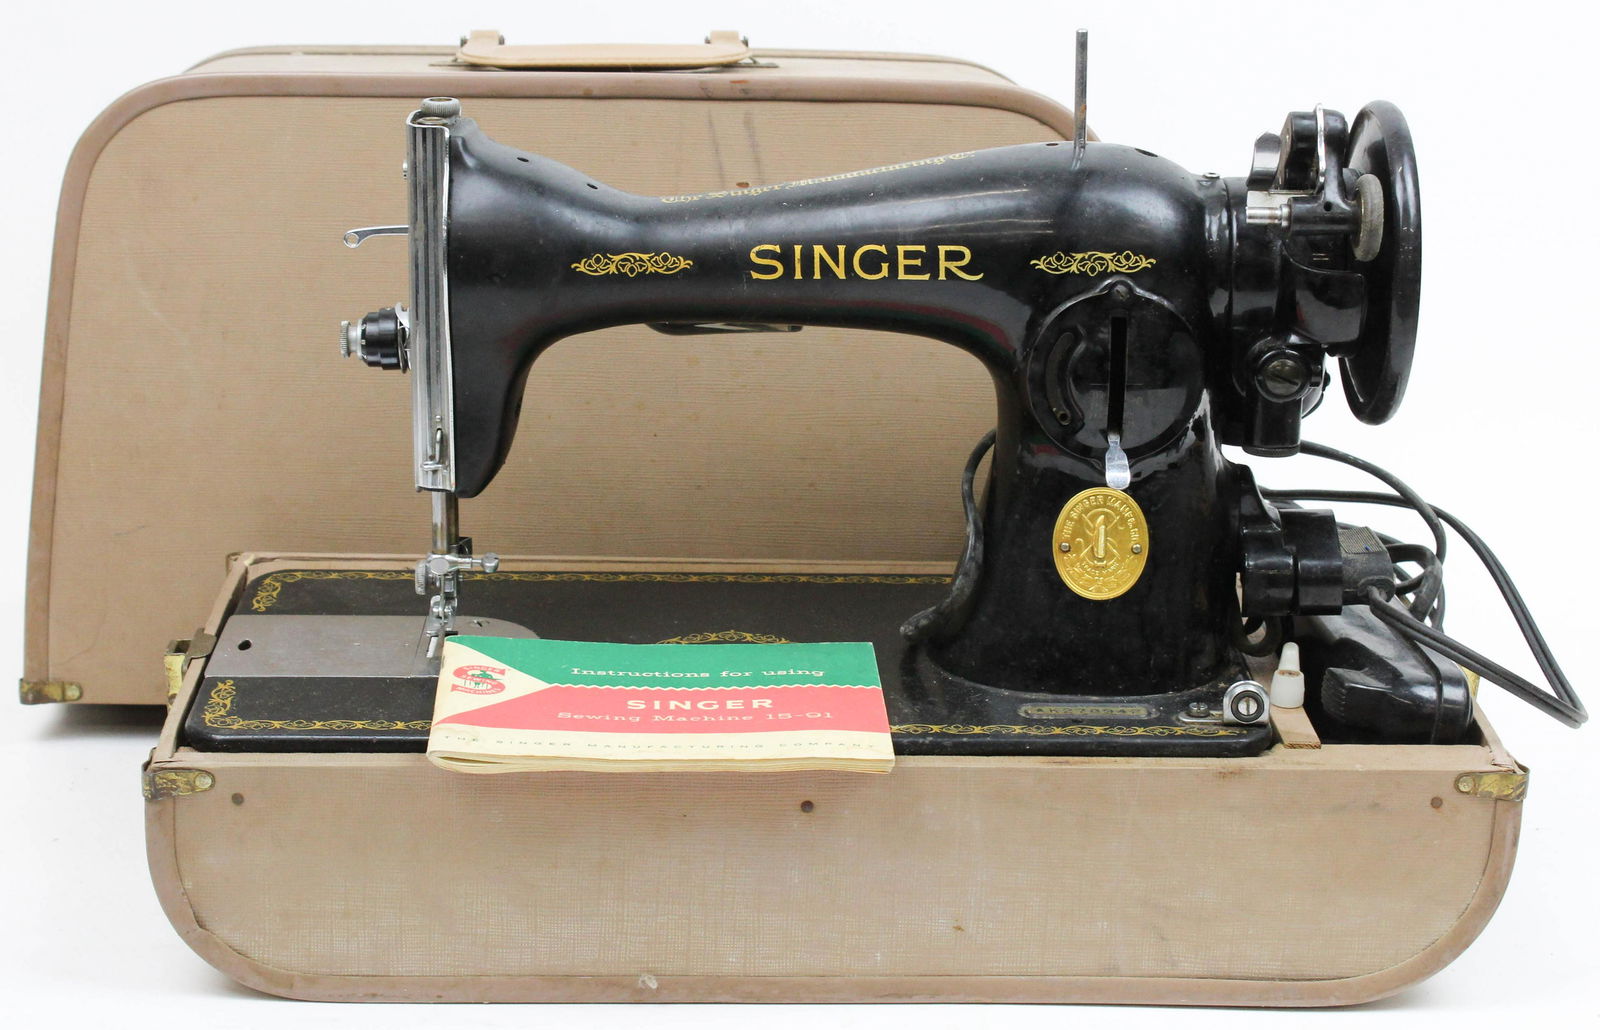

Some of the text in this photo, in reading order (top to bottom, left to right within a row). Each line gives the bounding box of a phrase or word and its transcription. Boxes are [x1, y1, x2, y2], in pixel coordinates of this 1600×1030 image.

[750, 244, 984, 281] SINGER
[571, 667, 825, 678] Instructions for using
[626, 699, 774, 710] SINGER
[557, 711, 833, 722] Sewing Machine 15-91
